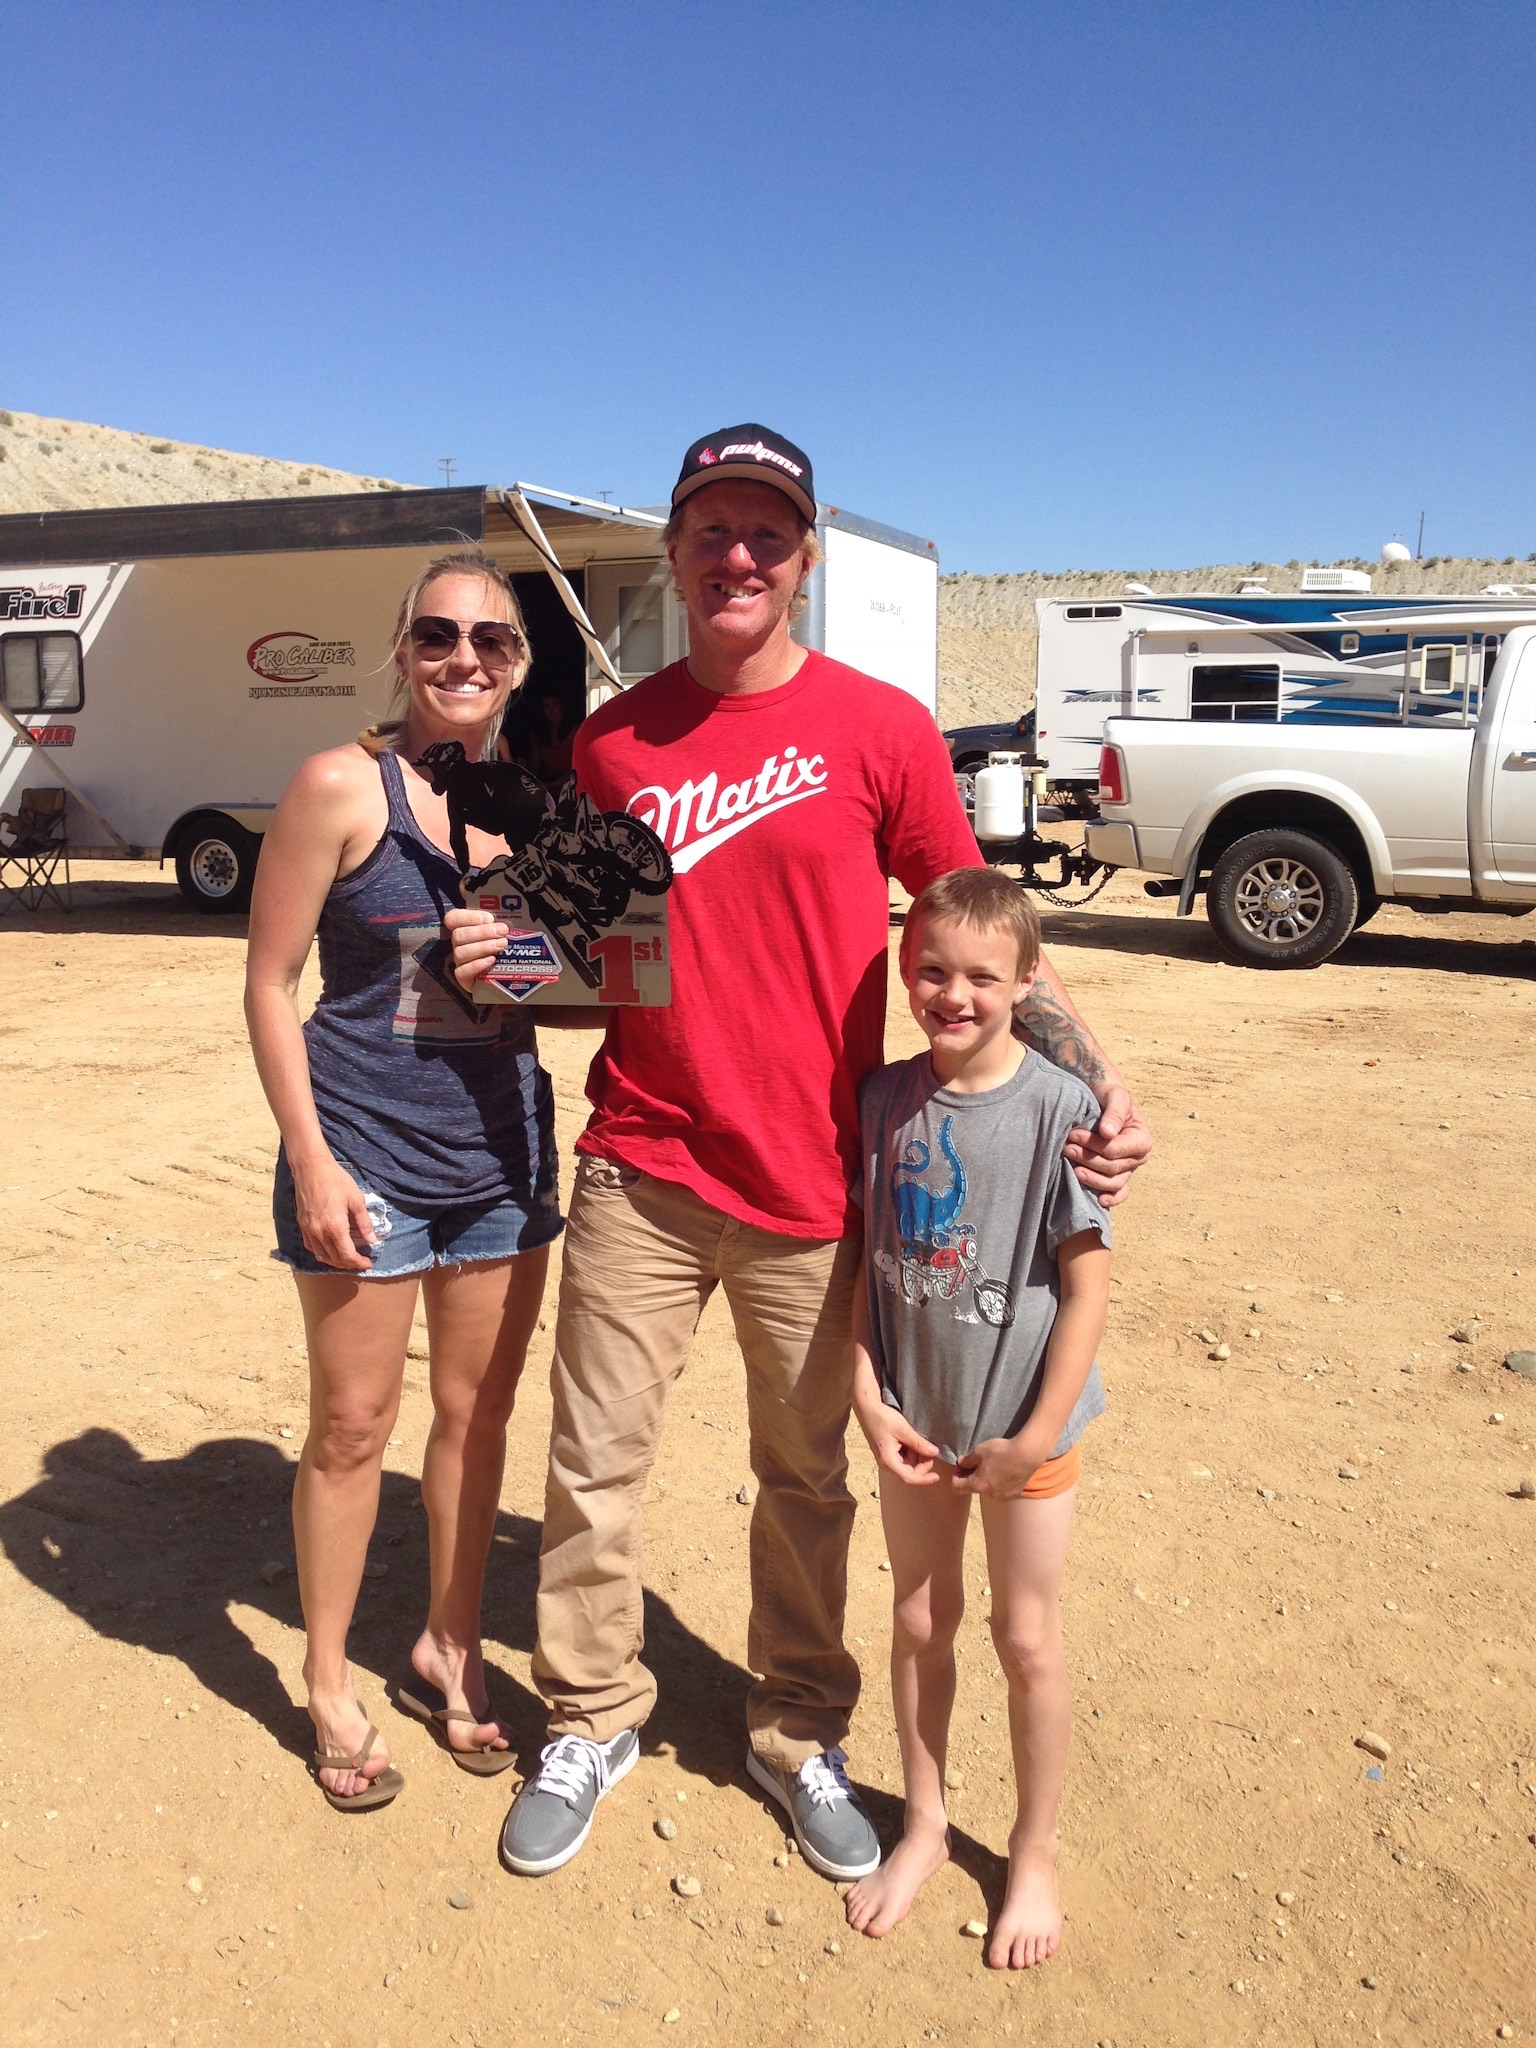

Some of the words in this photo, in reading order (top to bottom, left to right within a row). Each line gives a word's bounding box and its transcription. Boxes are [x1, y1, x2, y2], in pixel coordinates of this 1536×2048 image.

[287, 646, 356, 666] CALIBER
[625, 746, 828, 848] Matix
[492, 965, 553, 973] OTOCROSS
